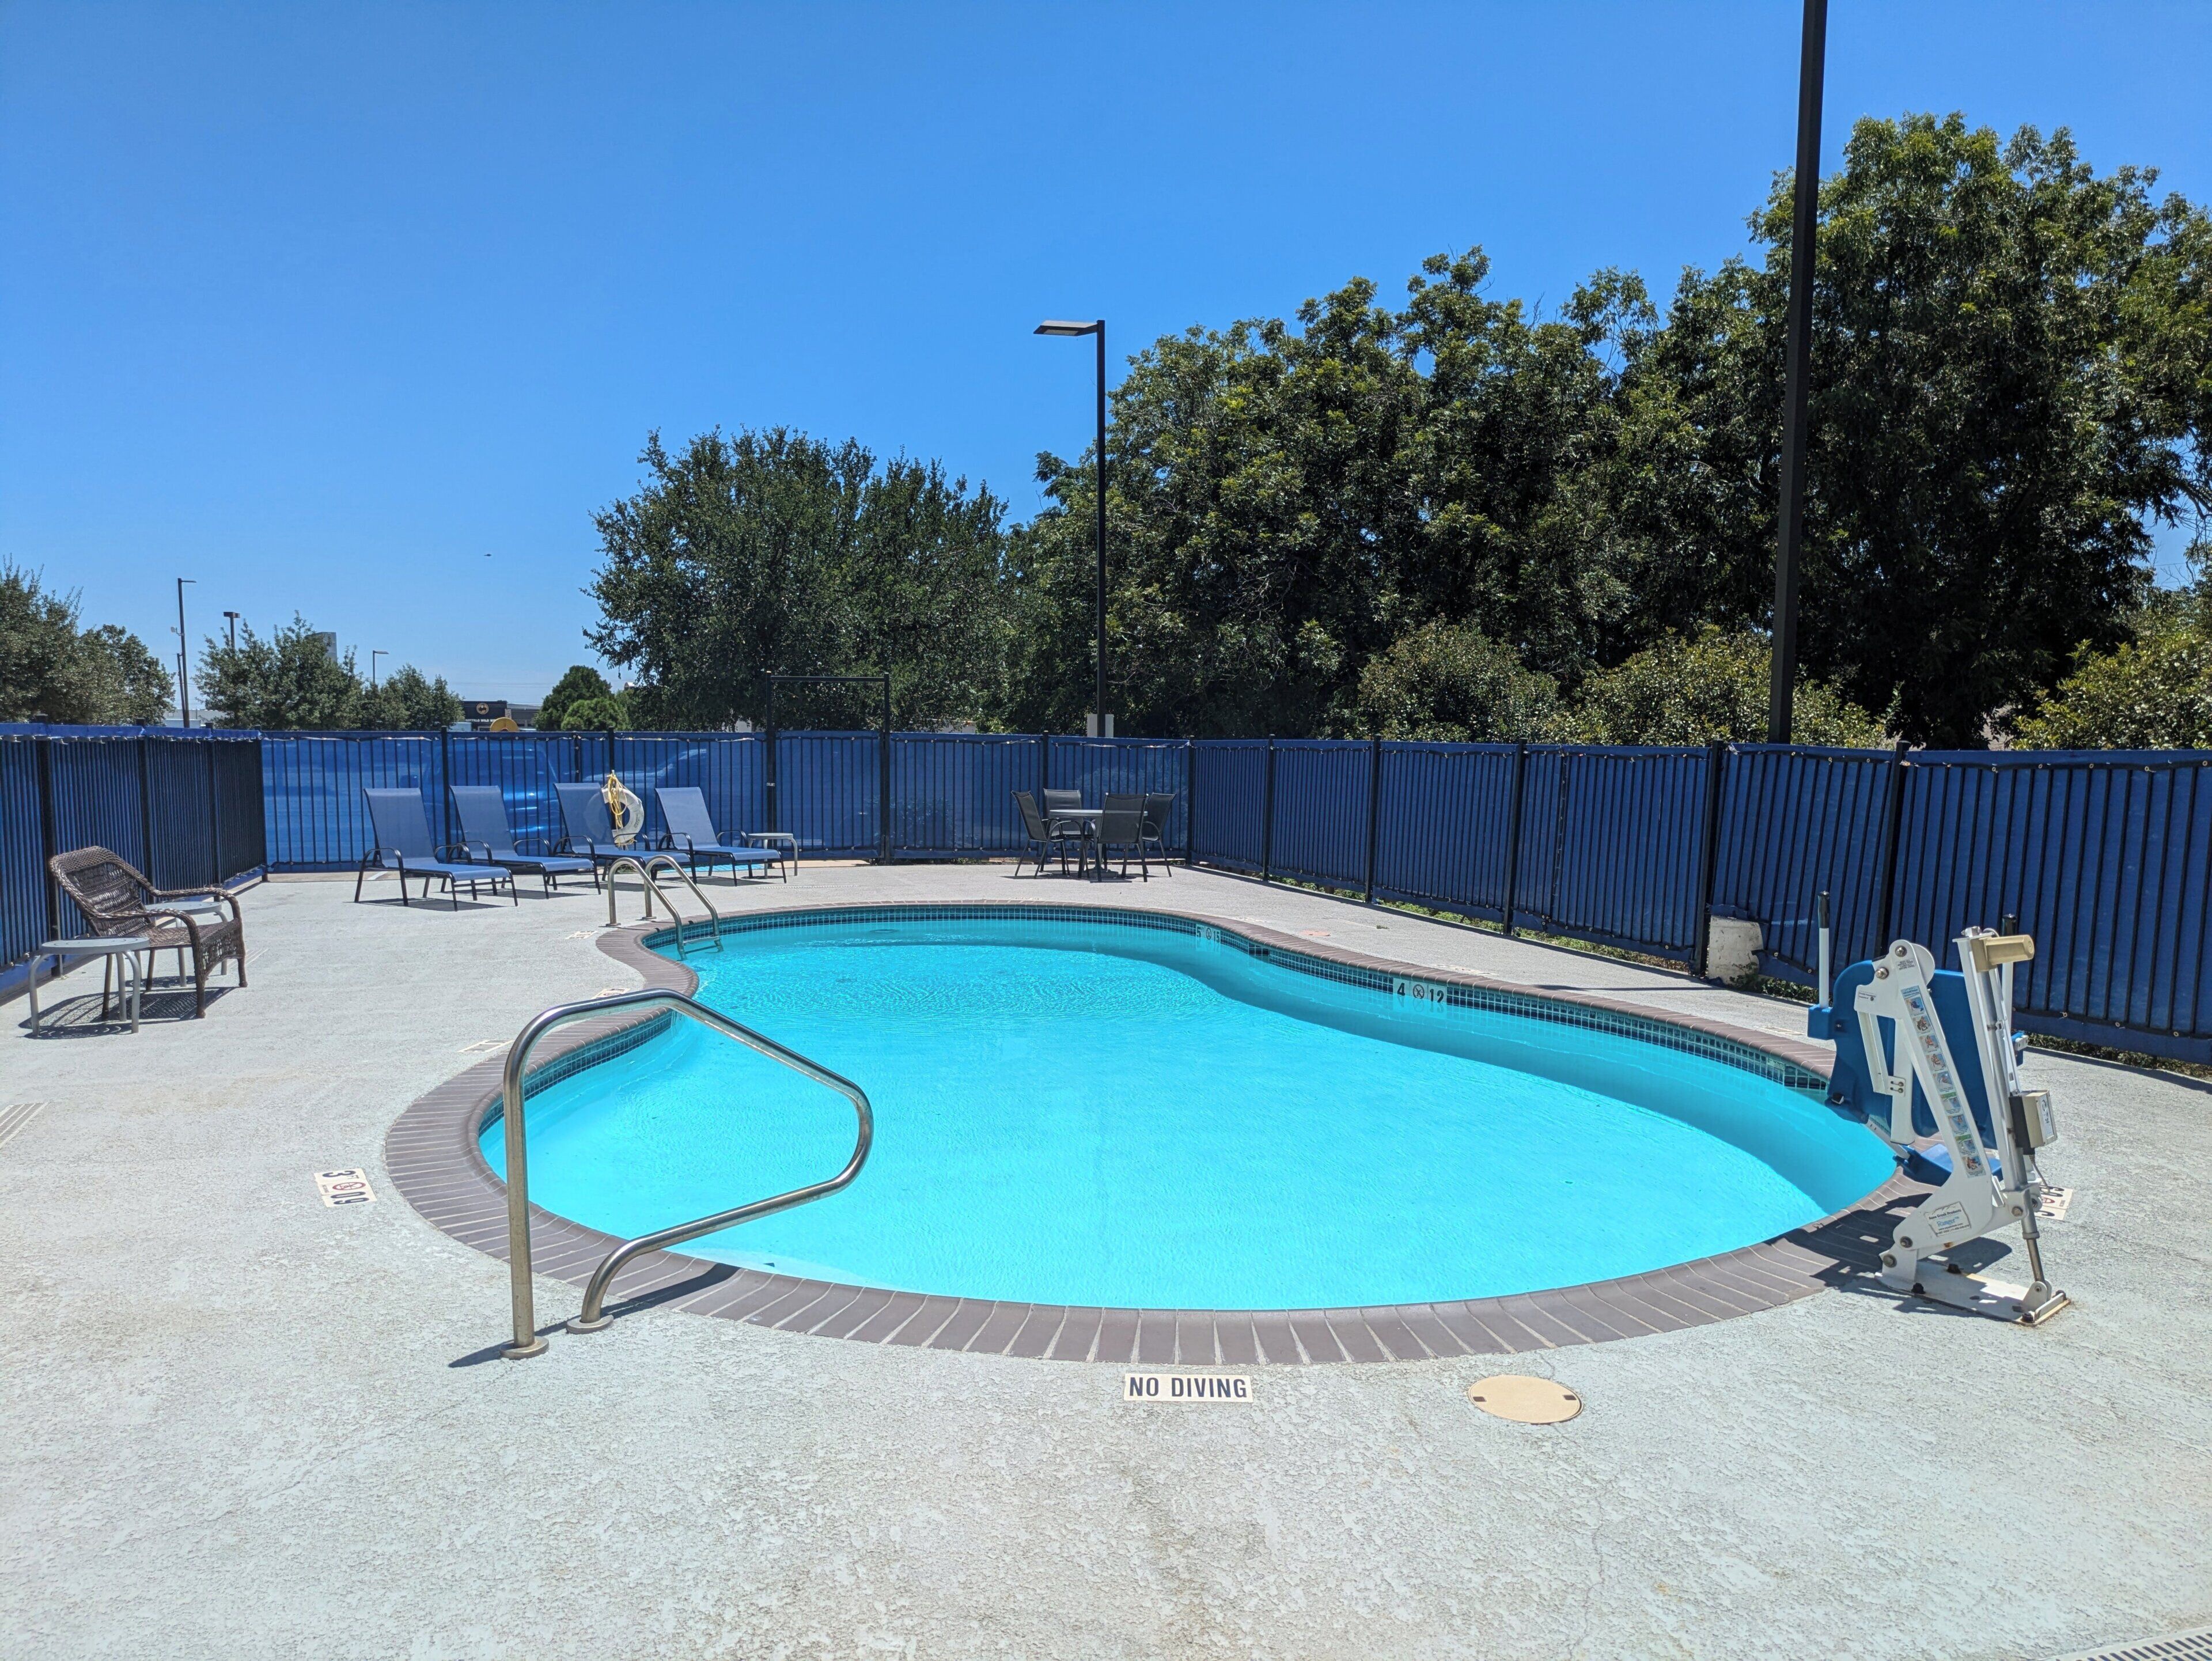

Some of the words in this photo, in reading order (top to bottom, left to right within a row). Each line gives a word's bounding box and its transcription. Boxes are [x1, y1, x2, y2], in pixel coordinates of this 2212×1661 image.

[1197, 926, 1201, 937] 5
[1397, 982, 1406, 996] 4
[1129, 1376, 1159, 1397] NO
[1171, 1377, 1247, 1398] DIVING
